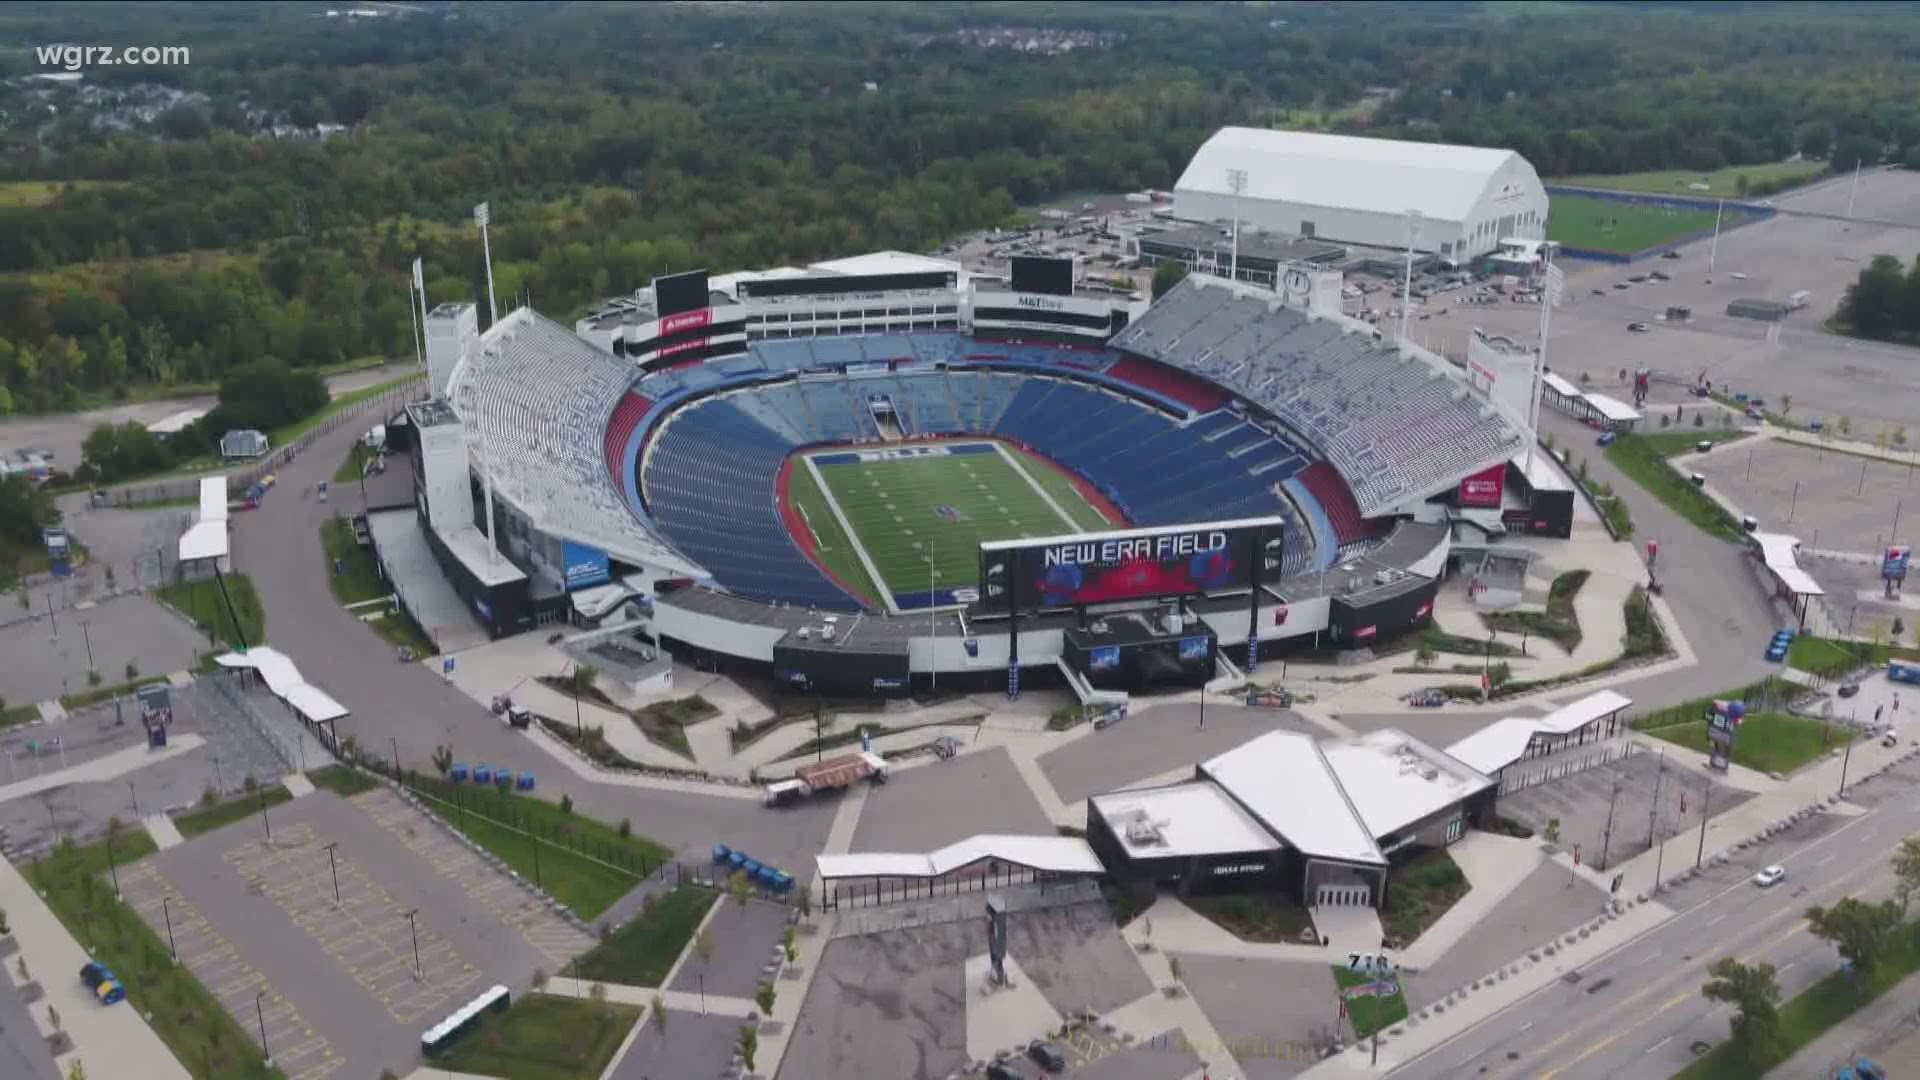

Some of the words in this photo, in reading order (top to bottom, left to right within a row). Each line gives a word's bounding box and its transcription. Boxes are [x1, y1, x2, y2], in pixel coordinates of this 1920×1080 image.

[1044, 544, 1096, 568] NEW
[1102, 538, 1151, 562] ERA
[1157, 531, 1227, 560] FIELD
